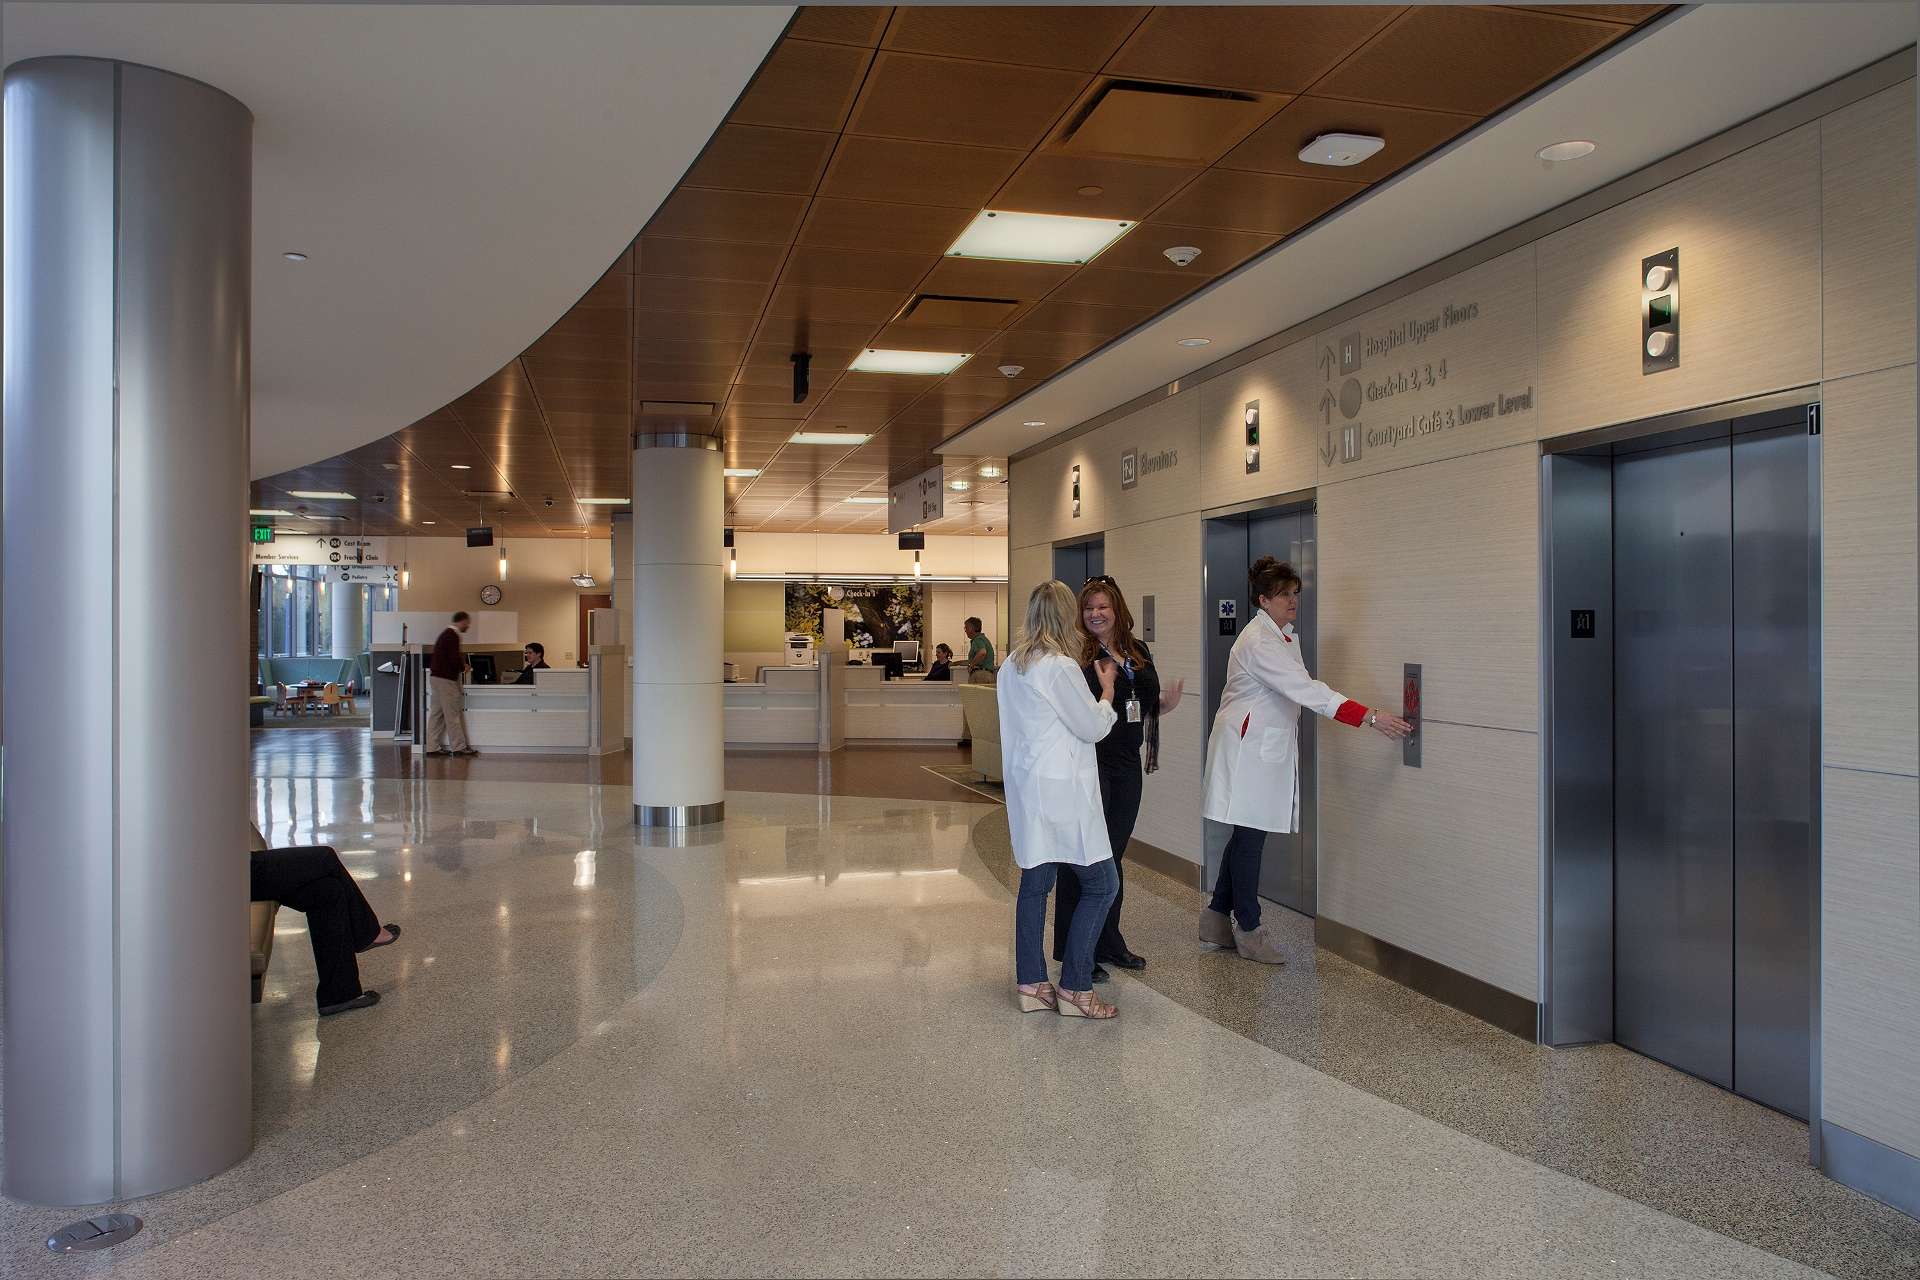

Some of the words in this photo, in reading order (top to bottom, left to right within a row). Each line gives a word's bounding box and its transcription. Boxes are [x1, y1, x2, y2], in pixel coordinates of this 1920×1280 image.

[1366, 321, 1406, 358] Hospital
[1409, 317, 1440, 345] Upper
[1443, 303, 1479, 329] Floors
[1367, 373, 1408, 401] Check-In
[1410, 369, 1421, 391] 2,
[1425, 363, 1436, 387] 3,
[1439, 358, 1447, 379] 4
[1367, 415, 1414, 448] Courtyard
[1417, 410, 1442, 435] Café
[1445, 409, 1454, 429] &
[1457, 401, 1496, 426] Lower
[1498, 386, 1533, 416] Level
[1809, 405, 1817, 435] 1
[1141, 450, 1178, 475] Elevators
[255, 528, 271, 542] EXIT
